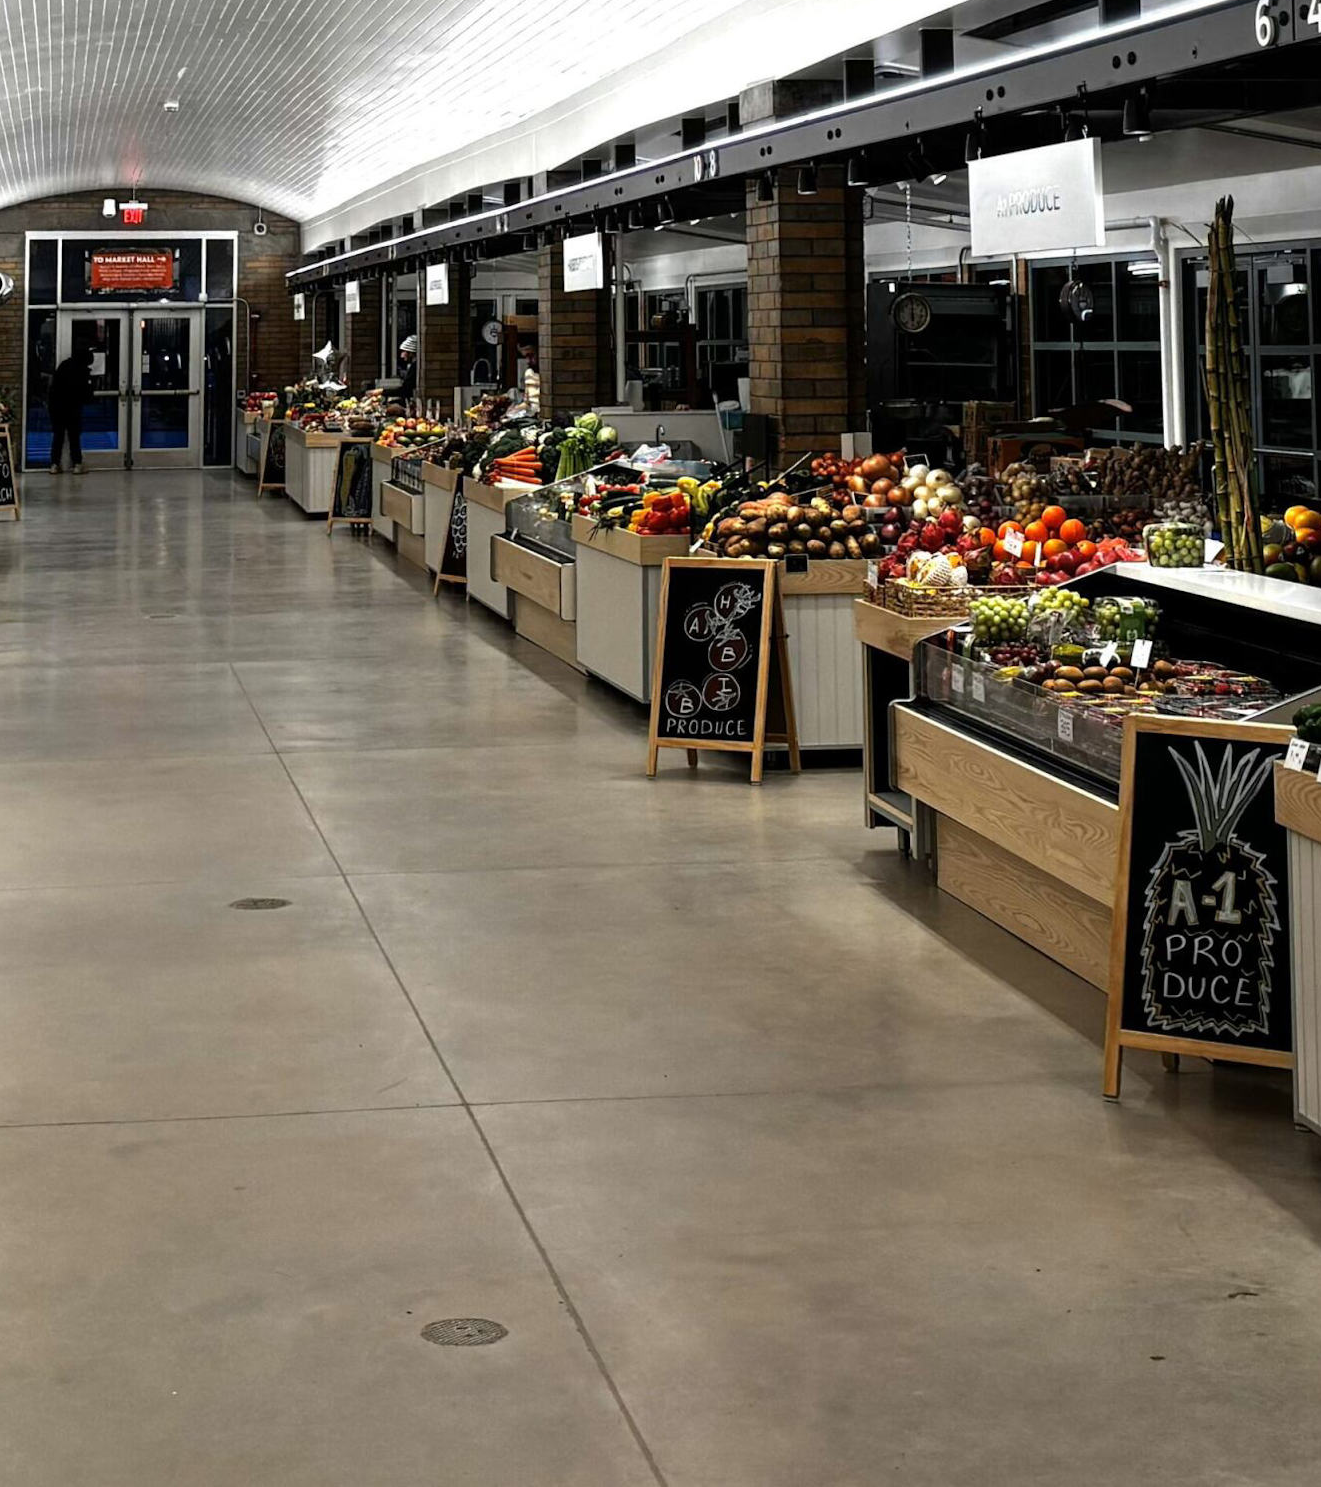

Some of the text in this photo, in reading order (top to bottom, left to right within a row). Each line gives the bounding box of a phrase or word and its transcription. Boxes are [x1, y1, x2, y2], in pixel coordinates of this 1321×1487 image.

[1007, 185, 1060, 217] PRODUCE
[123, 209, 143, 224] EXIT
[93, 256, 155, 264] TO MARKET HALL
[720, 595, 731, 610] H
[688, 616, 700, 635] A
[721, 646, 737, 663] B
[679, 697, 695, 714] B
[665, 717, 748, 736] PRODUCE
[1167, 869, 1242, 927] A-1
[1165, 933, 1243, 968] PRO
[1163, 971, 1253, 1007] DUCE
